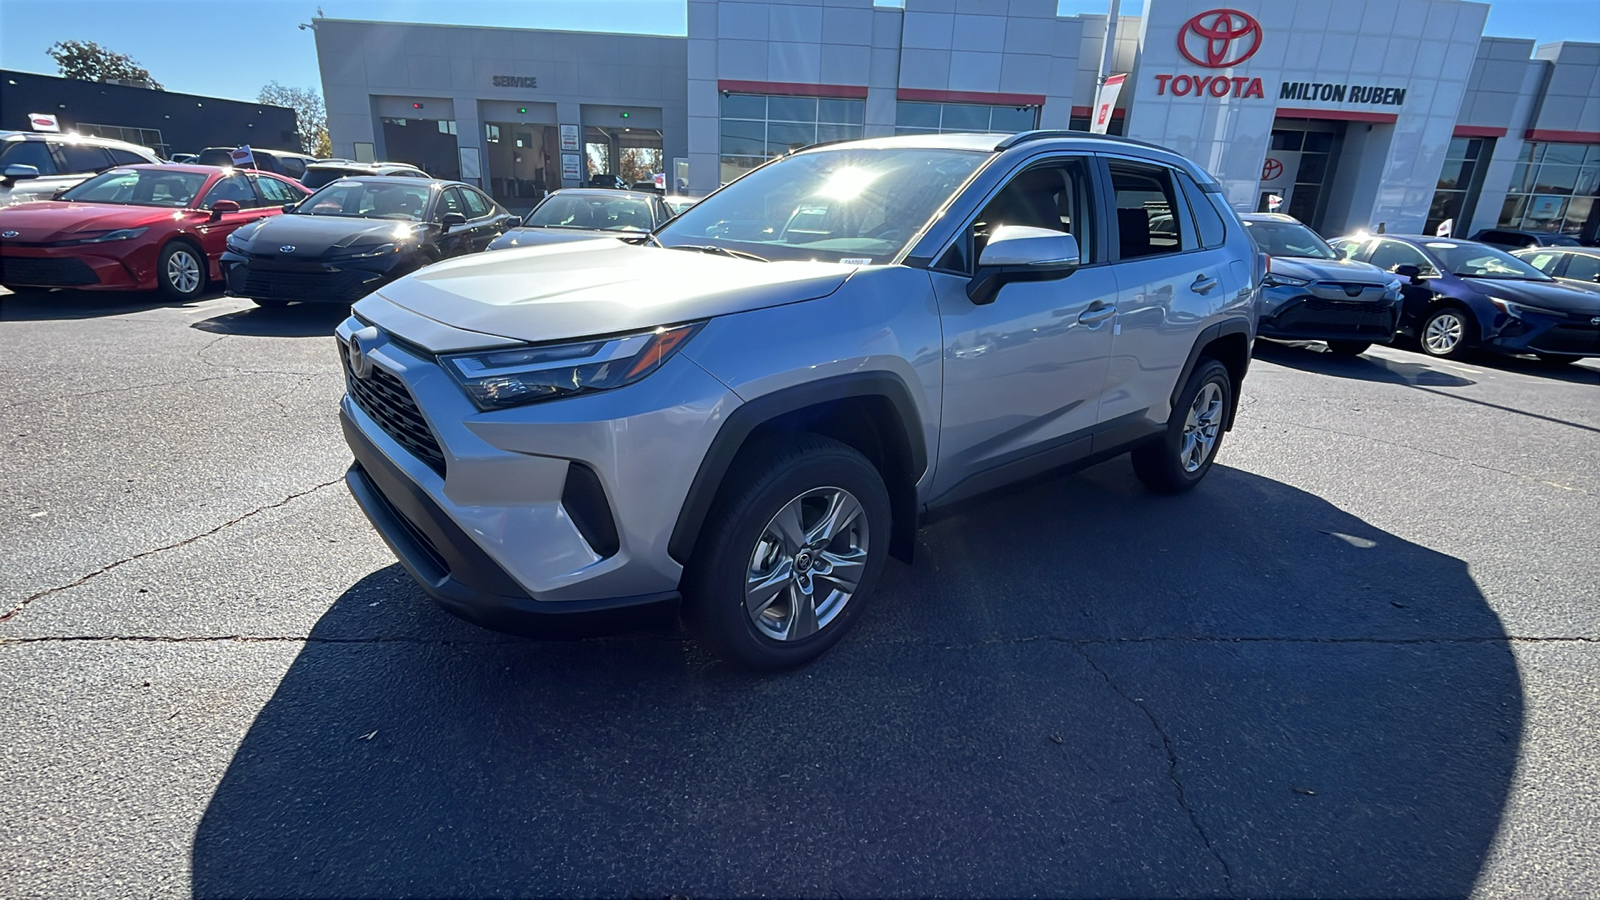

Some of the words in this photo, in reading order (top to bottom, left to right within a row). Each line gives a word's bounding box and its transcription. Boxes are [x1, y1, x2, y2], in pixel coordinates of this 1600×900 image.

[492, 75, 537, 88] SERVICE
[1155, 74, 1265, 99] TOYOTA
[1279, 81, 1347, 103] MILTON
[1348, 85, 1407, 106] RUBEN
